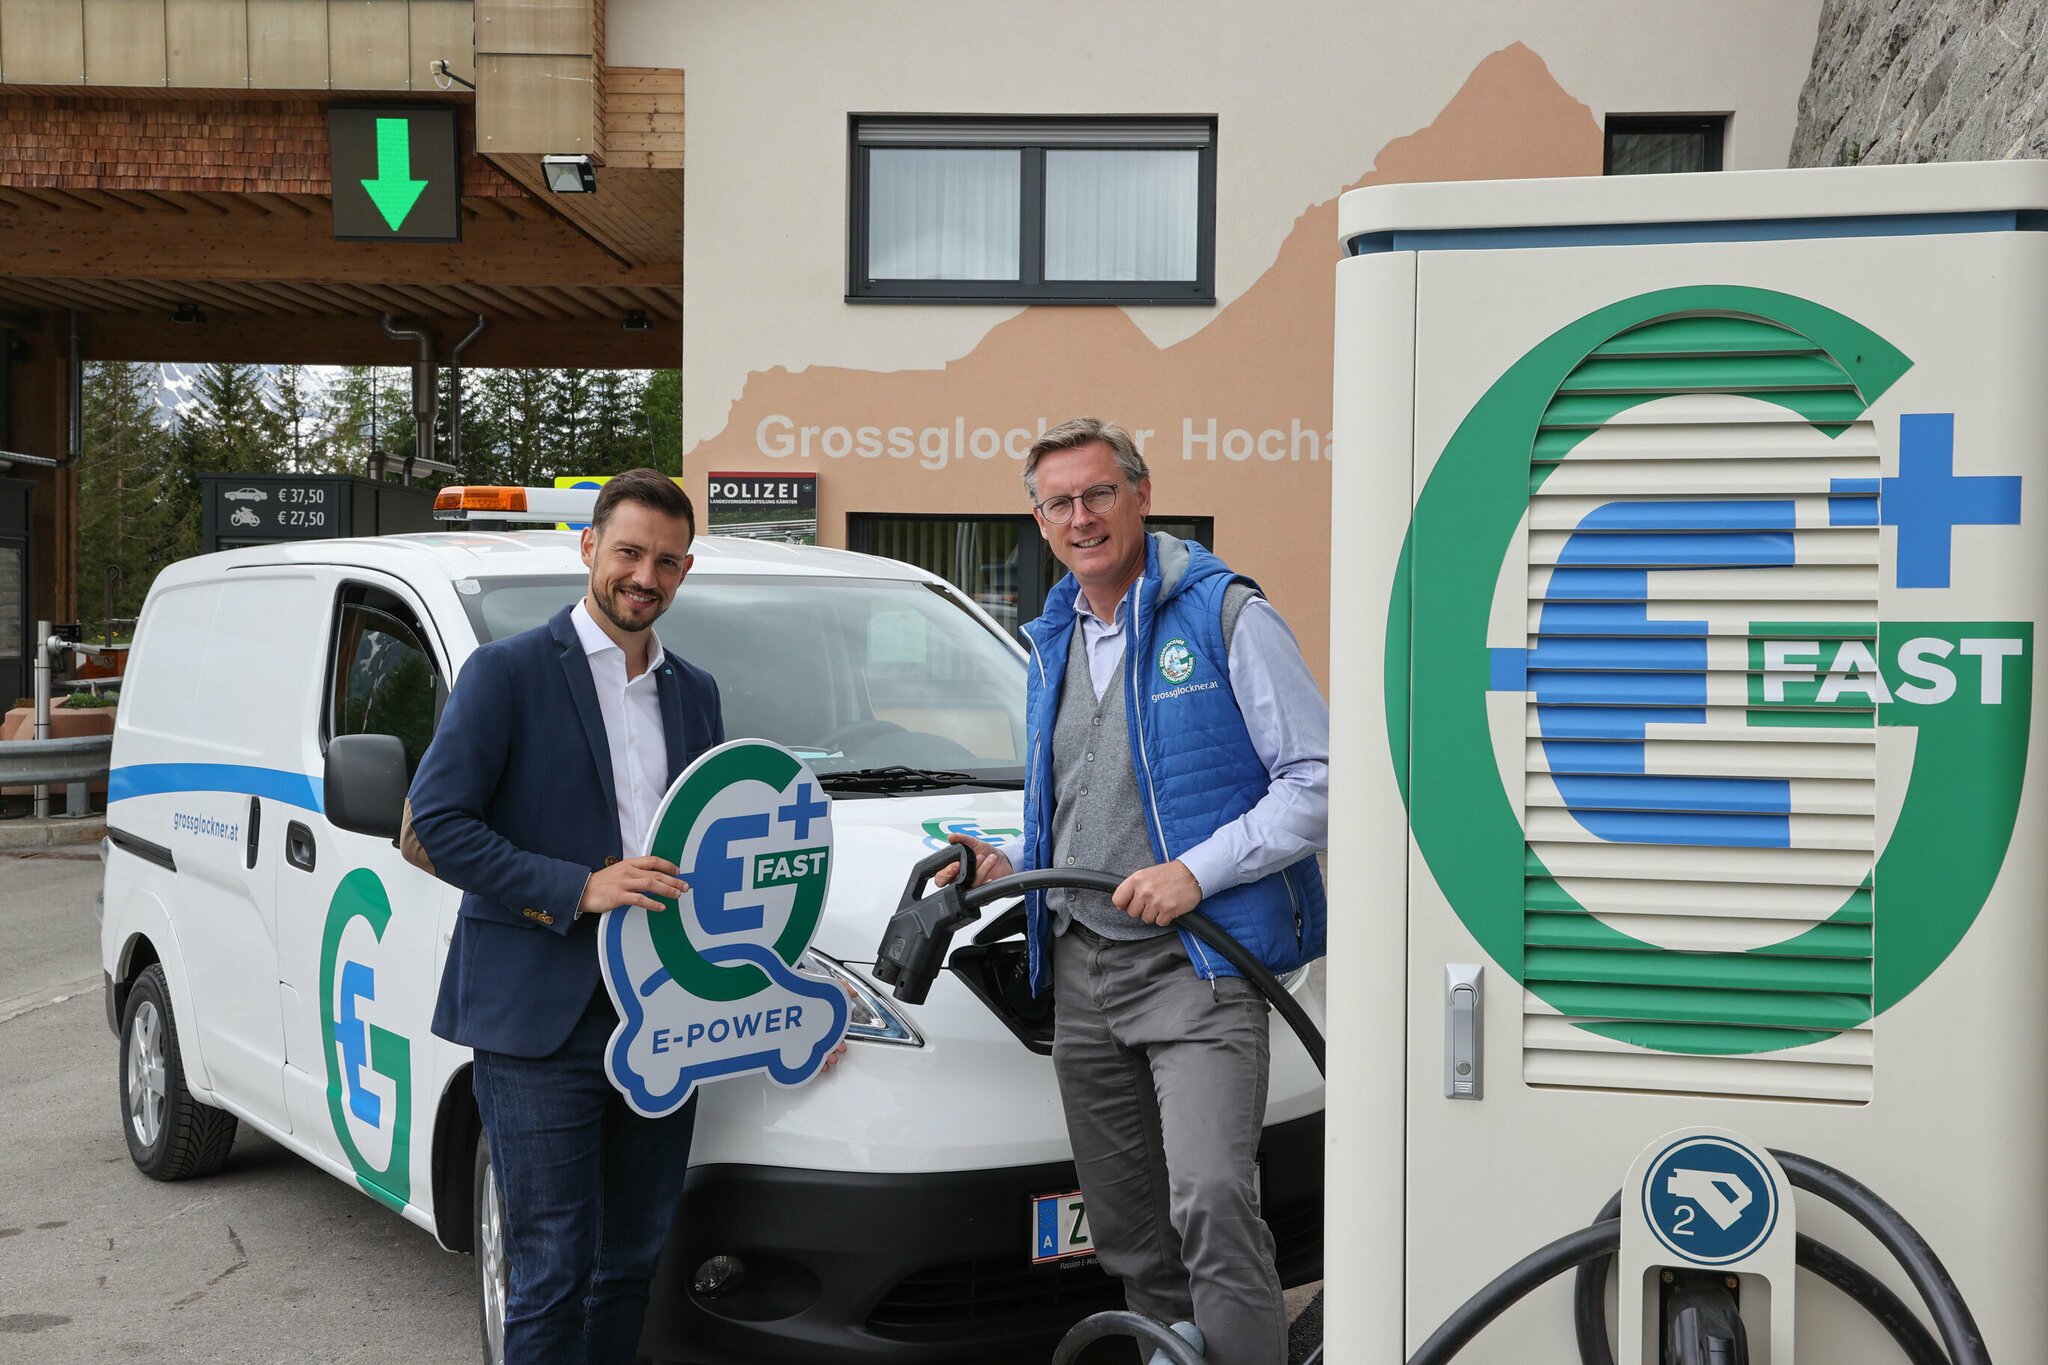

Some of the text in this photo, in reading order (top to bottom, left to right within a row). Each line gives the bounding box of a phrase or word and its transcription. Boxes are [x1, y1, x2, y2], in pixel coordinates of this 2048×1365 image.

[756, 414, 1332, 470] Grossglocr Hoch
[278, 488, 324, 505] € 37,50
[709, 483, 798, 498] POLIZEI
[278, 511, 325, 527] € 27,50
[1762, 637, 2023, 706] FAST
[1151, 681, 1219, 703] grossglockner.at
[174, 812, 239, 841] grossglockner.at
[757, 852, 826, 883] FAST
[652, 1006, 804, 1055] E-POWER
[1672, 1206, 1696, 1236] 2
[1043, 1235, 1053, 1248] A
